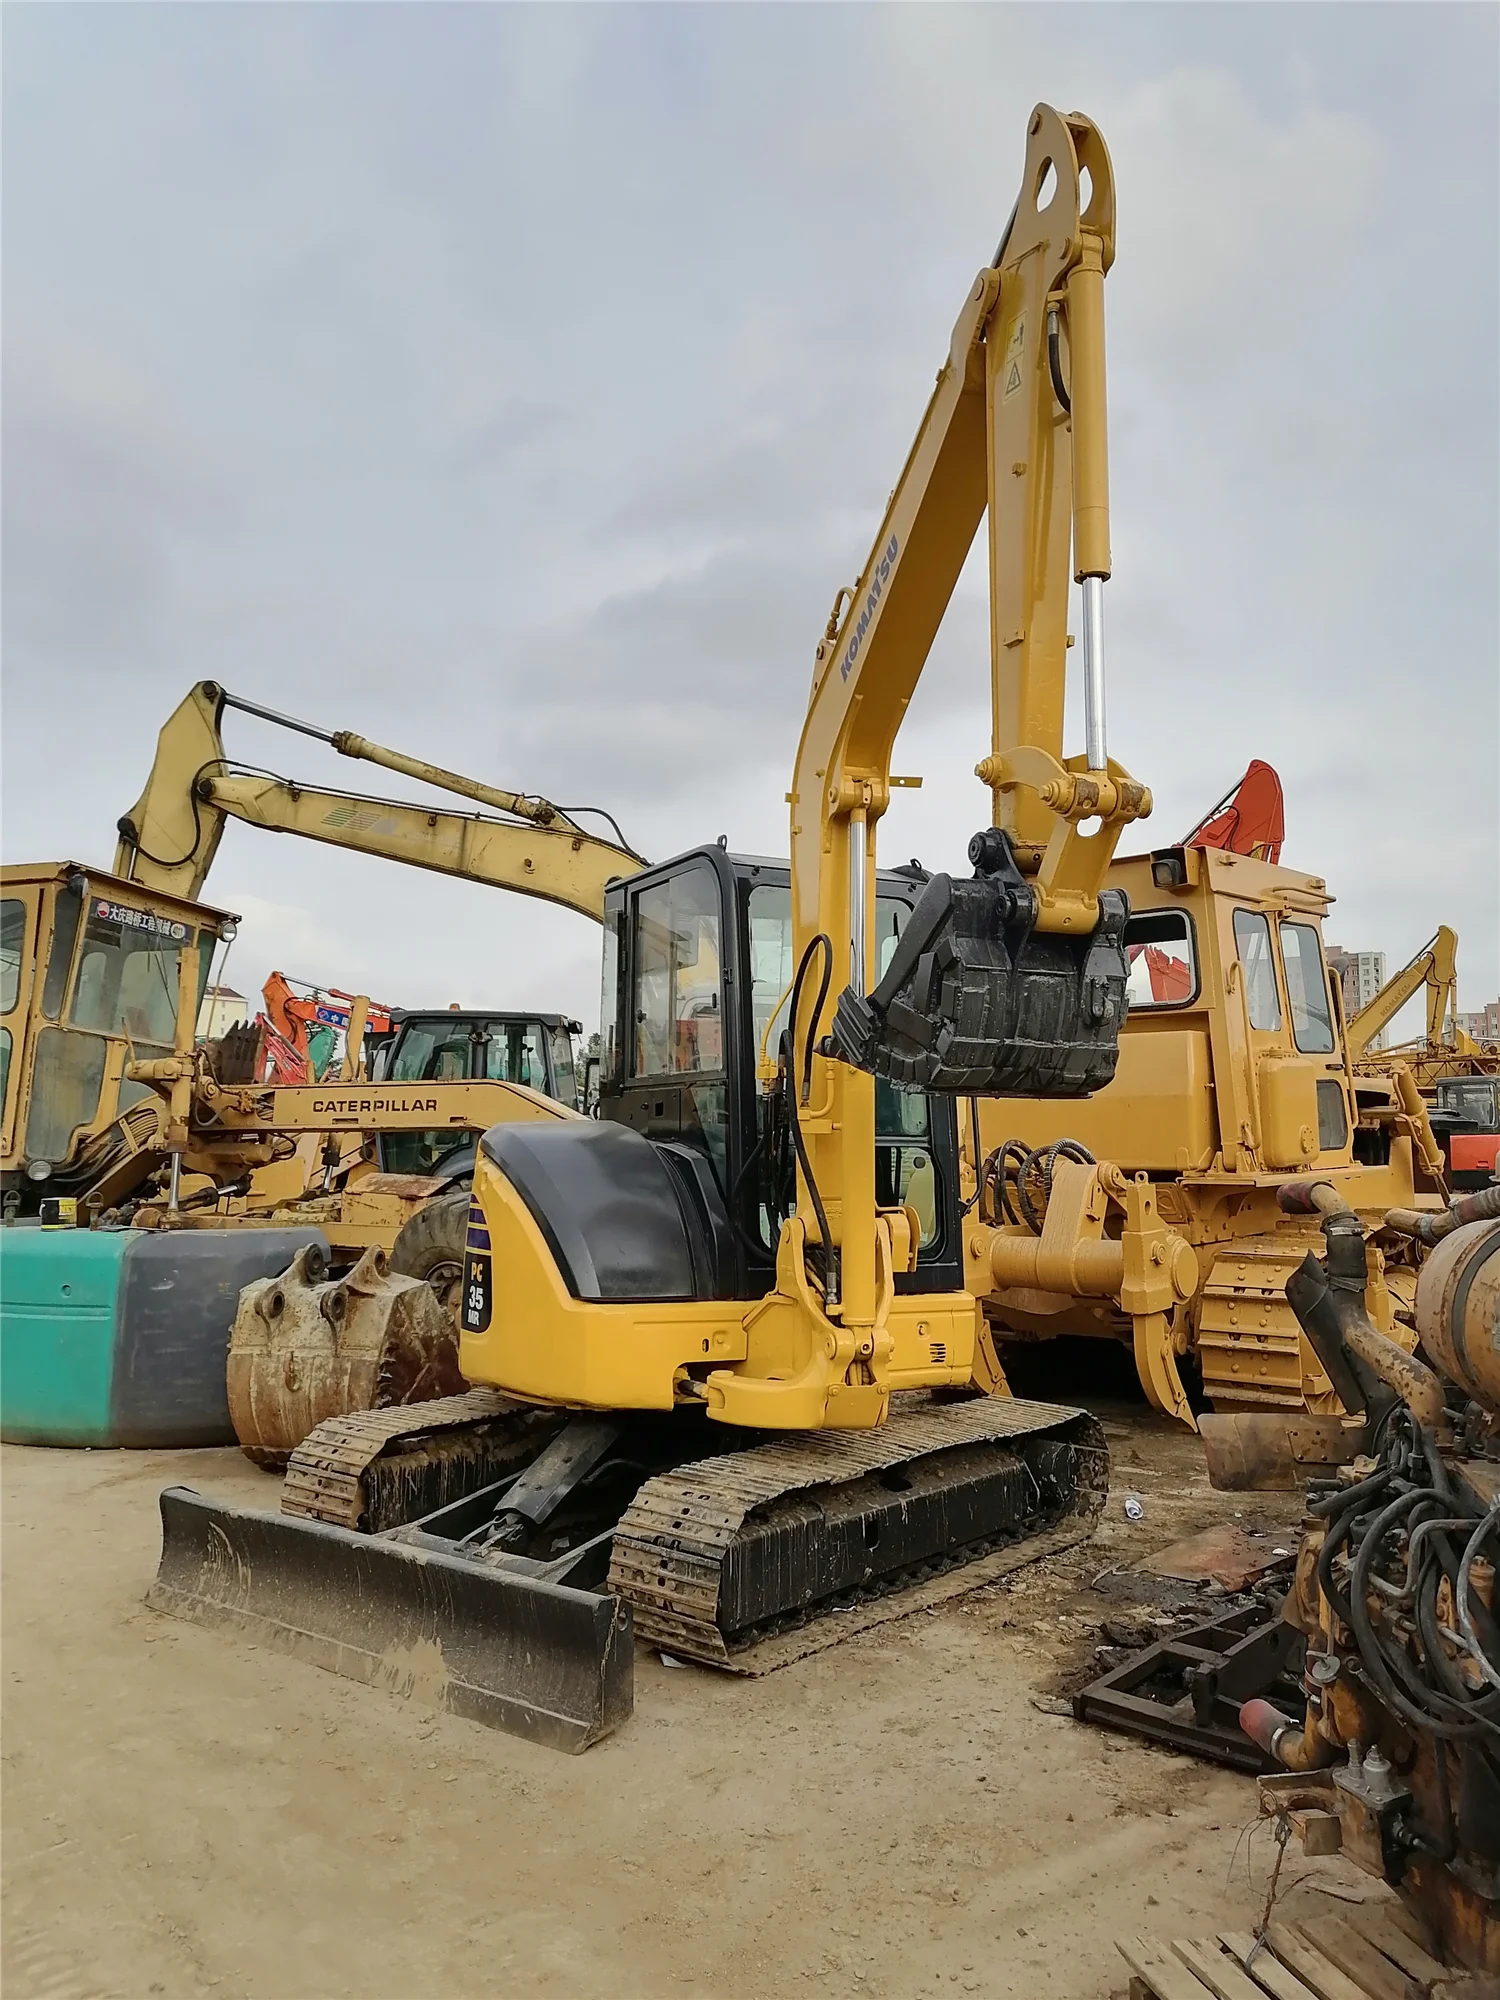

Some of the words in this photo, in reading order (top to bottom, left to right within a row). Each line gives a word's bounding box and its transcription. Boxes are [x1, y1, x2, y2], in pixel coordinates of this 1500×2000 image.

[839, 533, 899, 684] KOMATSU
[1380, 984, 1411, 1016] KOMATSU
[313, 1099, 437, 1113] CATERPILLAR
[470, 1261, 483, 1283] PC
[468, 1285, 484, 1310] 35
[467, 1309, 480, 1326] MR
